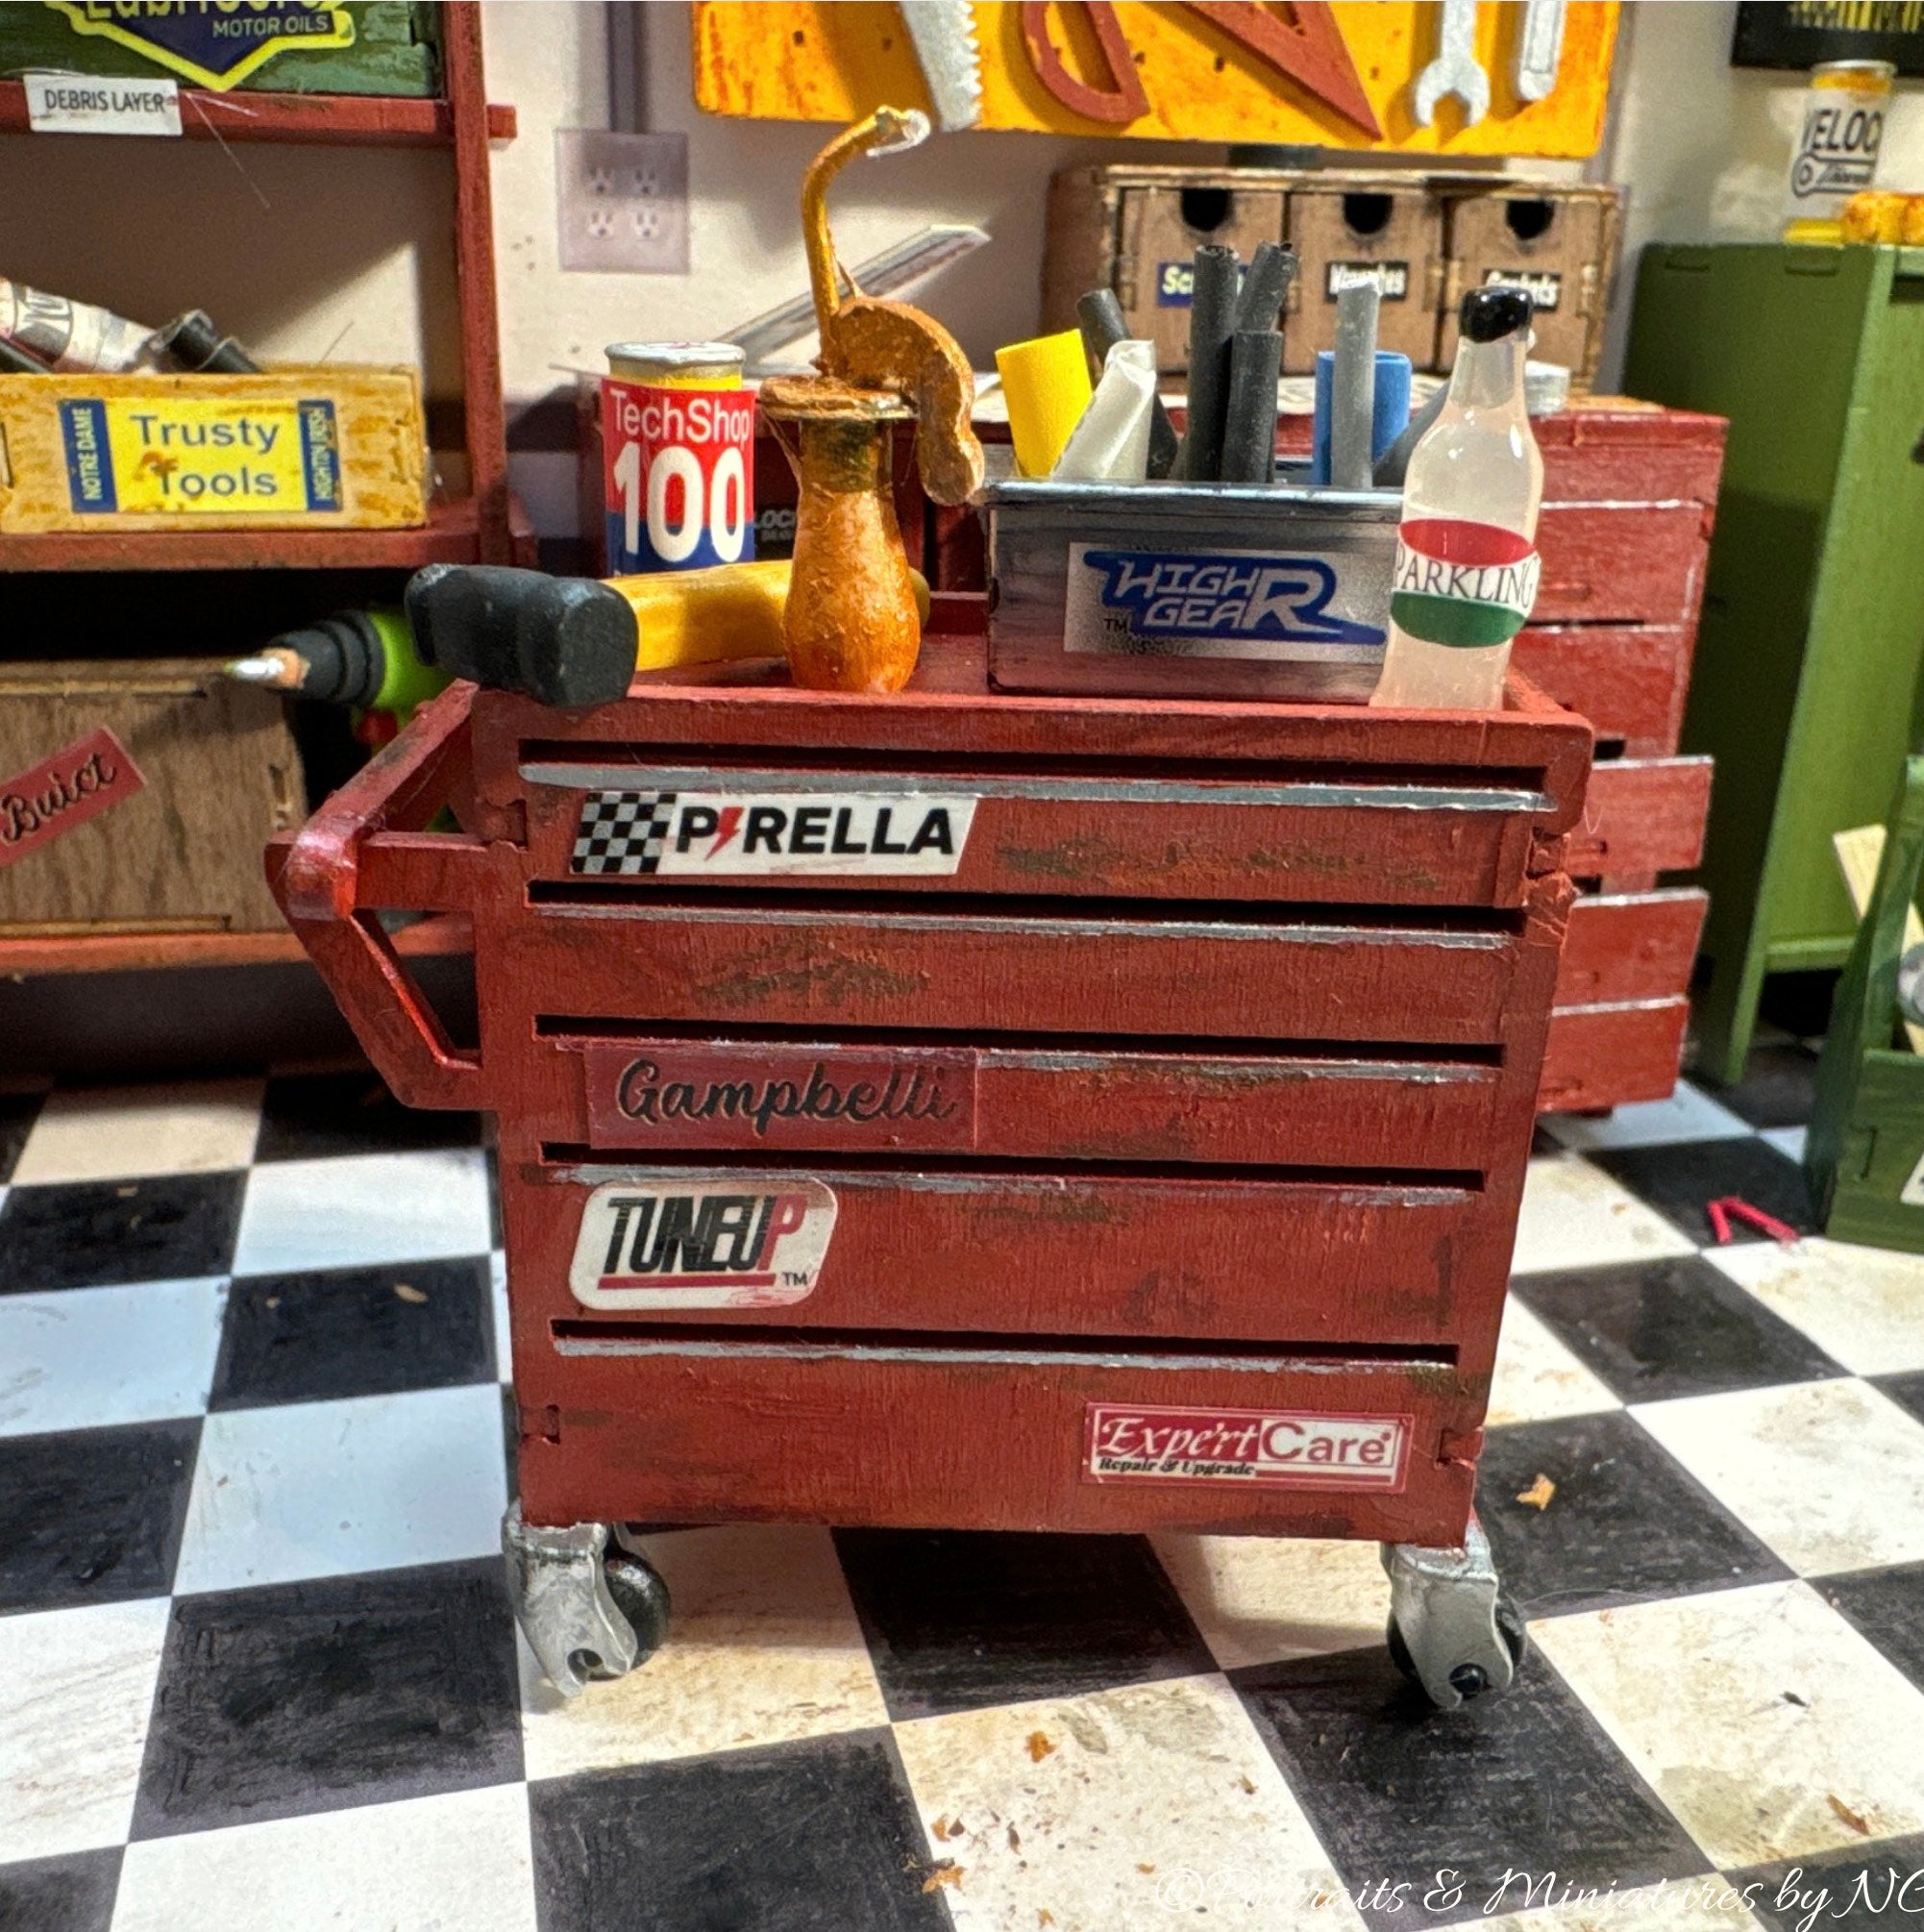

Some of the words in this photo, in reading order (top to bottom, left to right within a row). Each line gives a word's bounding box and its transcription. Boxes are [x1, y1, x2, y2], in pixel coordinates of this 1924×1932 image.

[212, 16, 281, 37] MOTOR
[284, 14, 329, 33] OILS
[44, 88, 108, 111] DEBRIS
[111, 91, 165, 113] LAYER
[131, 414, 279, 455] Trusty
[151, 458, 278, 498] Tools
[613, 440, 745, 563] 100
[1114, 559, 1261, 598] HIGH
[616, 1059, 960, 1135] Gampbelli
[604, 1194, 808, 1274] TUNEUP
[782, 1272, 808, 1286] TM
[1098, 1458, 1157, 1473] Repair
[1159, 1459, 1180, 1473] &
[1182, 1461, 1255, 1476] Upgrade
